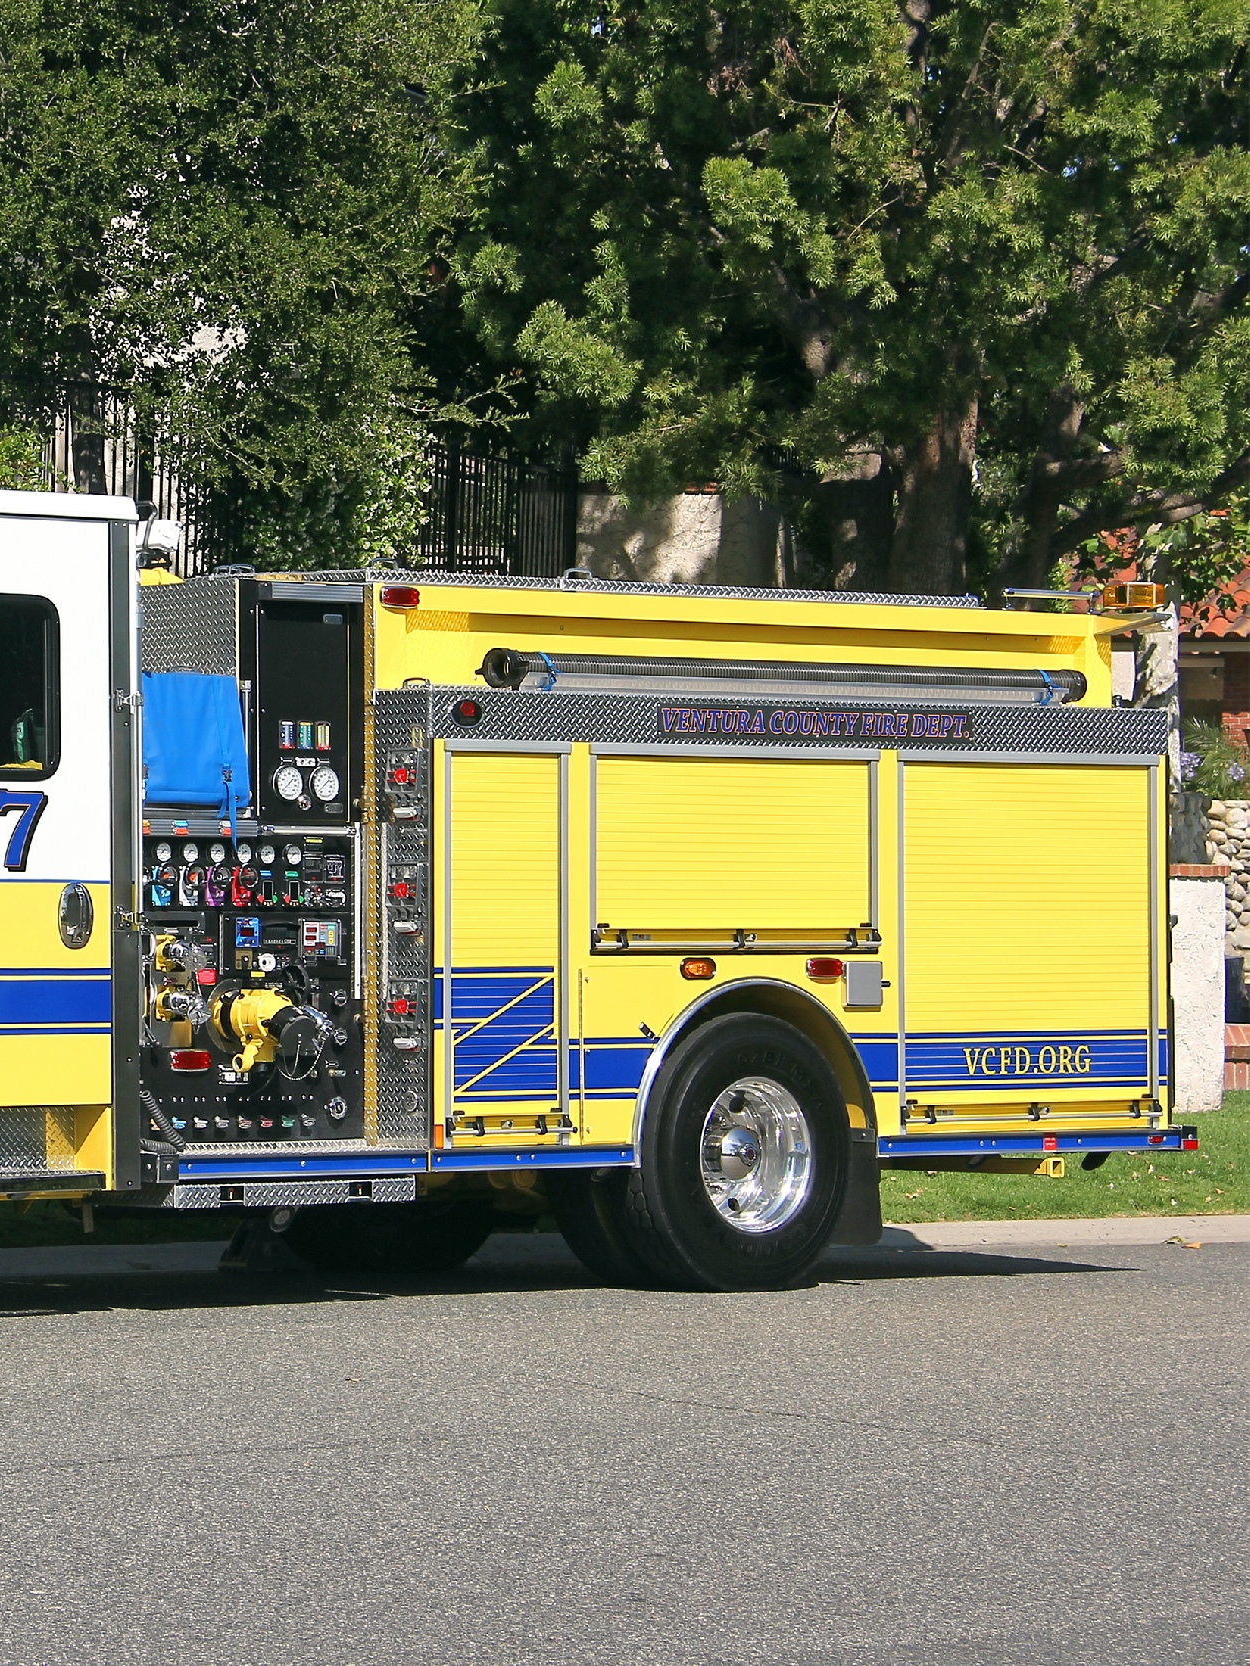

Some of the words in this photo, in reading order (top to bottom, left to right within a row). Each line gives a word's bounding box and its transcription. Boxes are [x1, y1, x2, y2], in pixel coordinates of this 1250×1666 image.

[660, 707, 766, 735] VENTURA
[769, 711, 859, 737] COUNTY
[859, 712, 908, 737] FIRE
[910, 714, 971, 739] DEPT.
[963, 1044, 1091, 1076] VCFD.ORG
